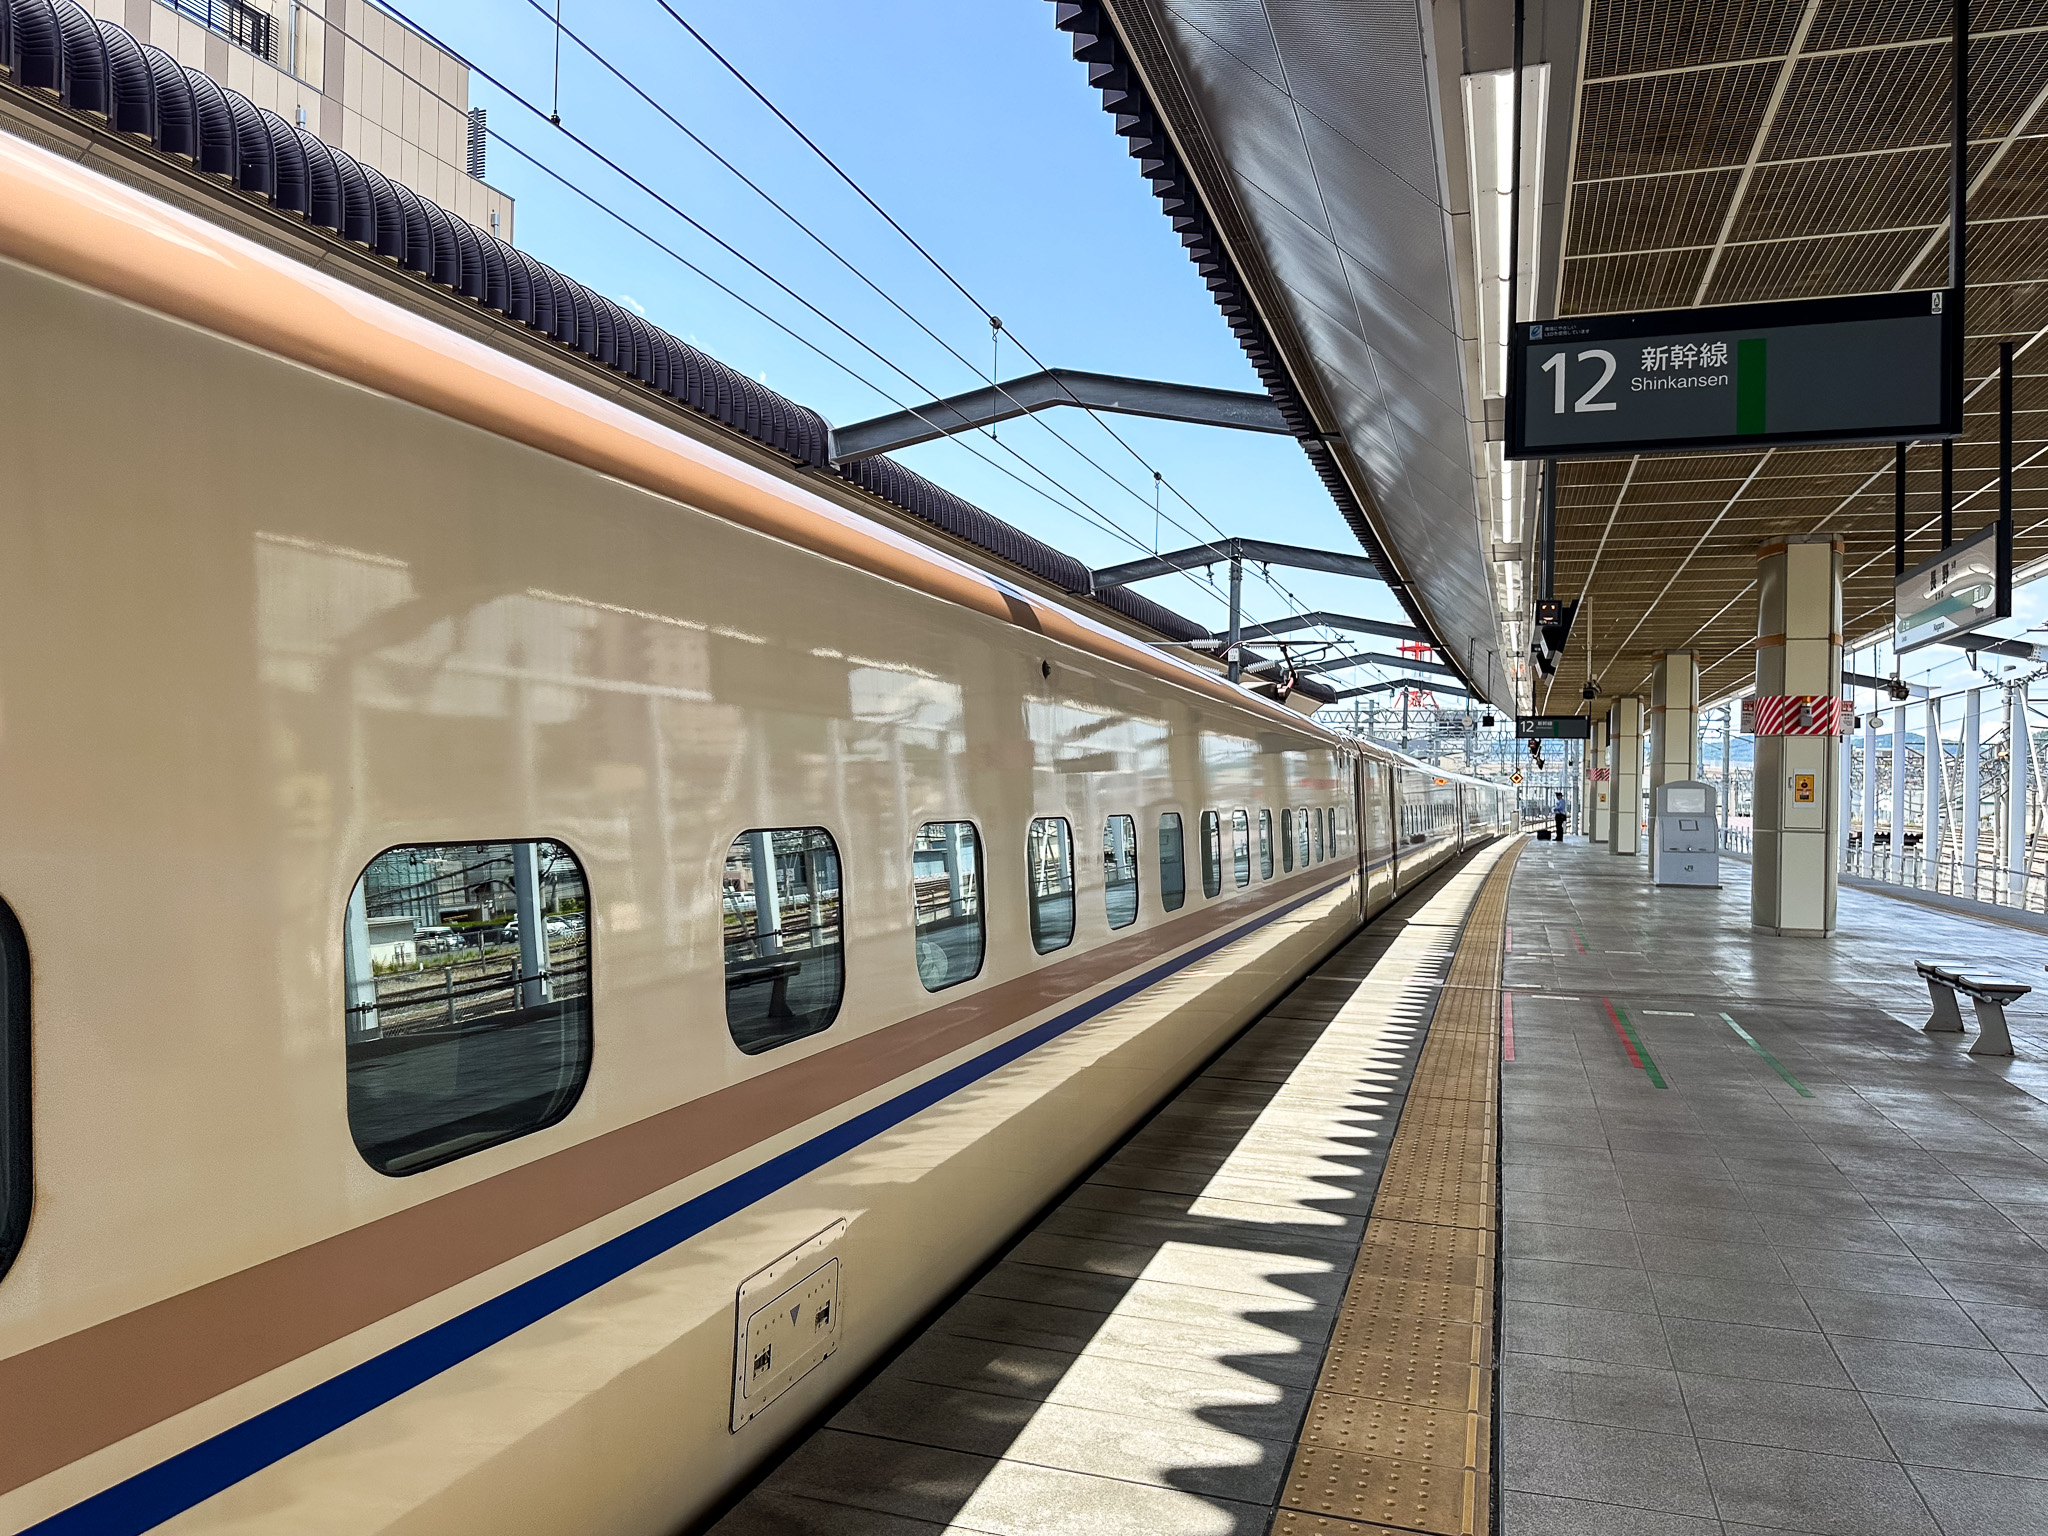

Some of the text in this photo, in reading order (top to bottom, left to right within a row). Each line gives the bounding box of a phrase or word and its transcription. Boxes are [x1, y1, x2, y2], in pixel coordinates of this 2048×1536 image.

[1641, 342, 1728, 372] 新幹線
[1541, 349, 1617, 414] 12
[1630, 374, 1728, 392] Shinkansen
[1520, 720, 1534, 733] 12
